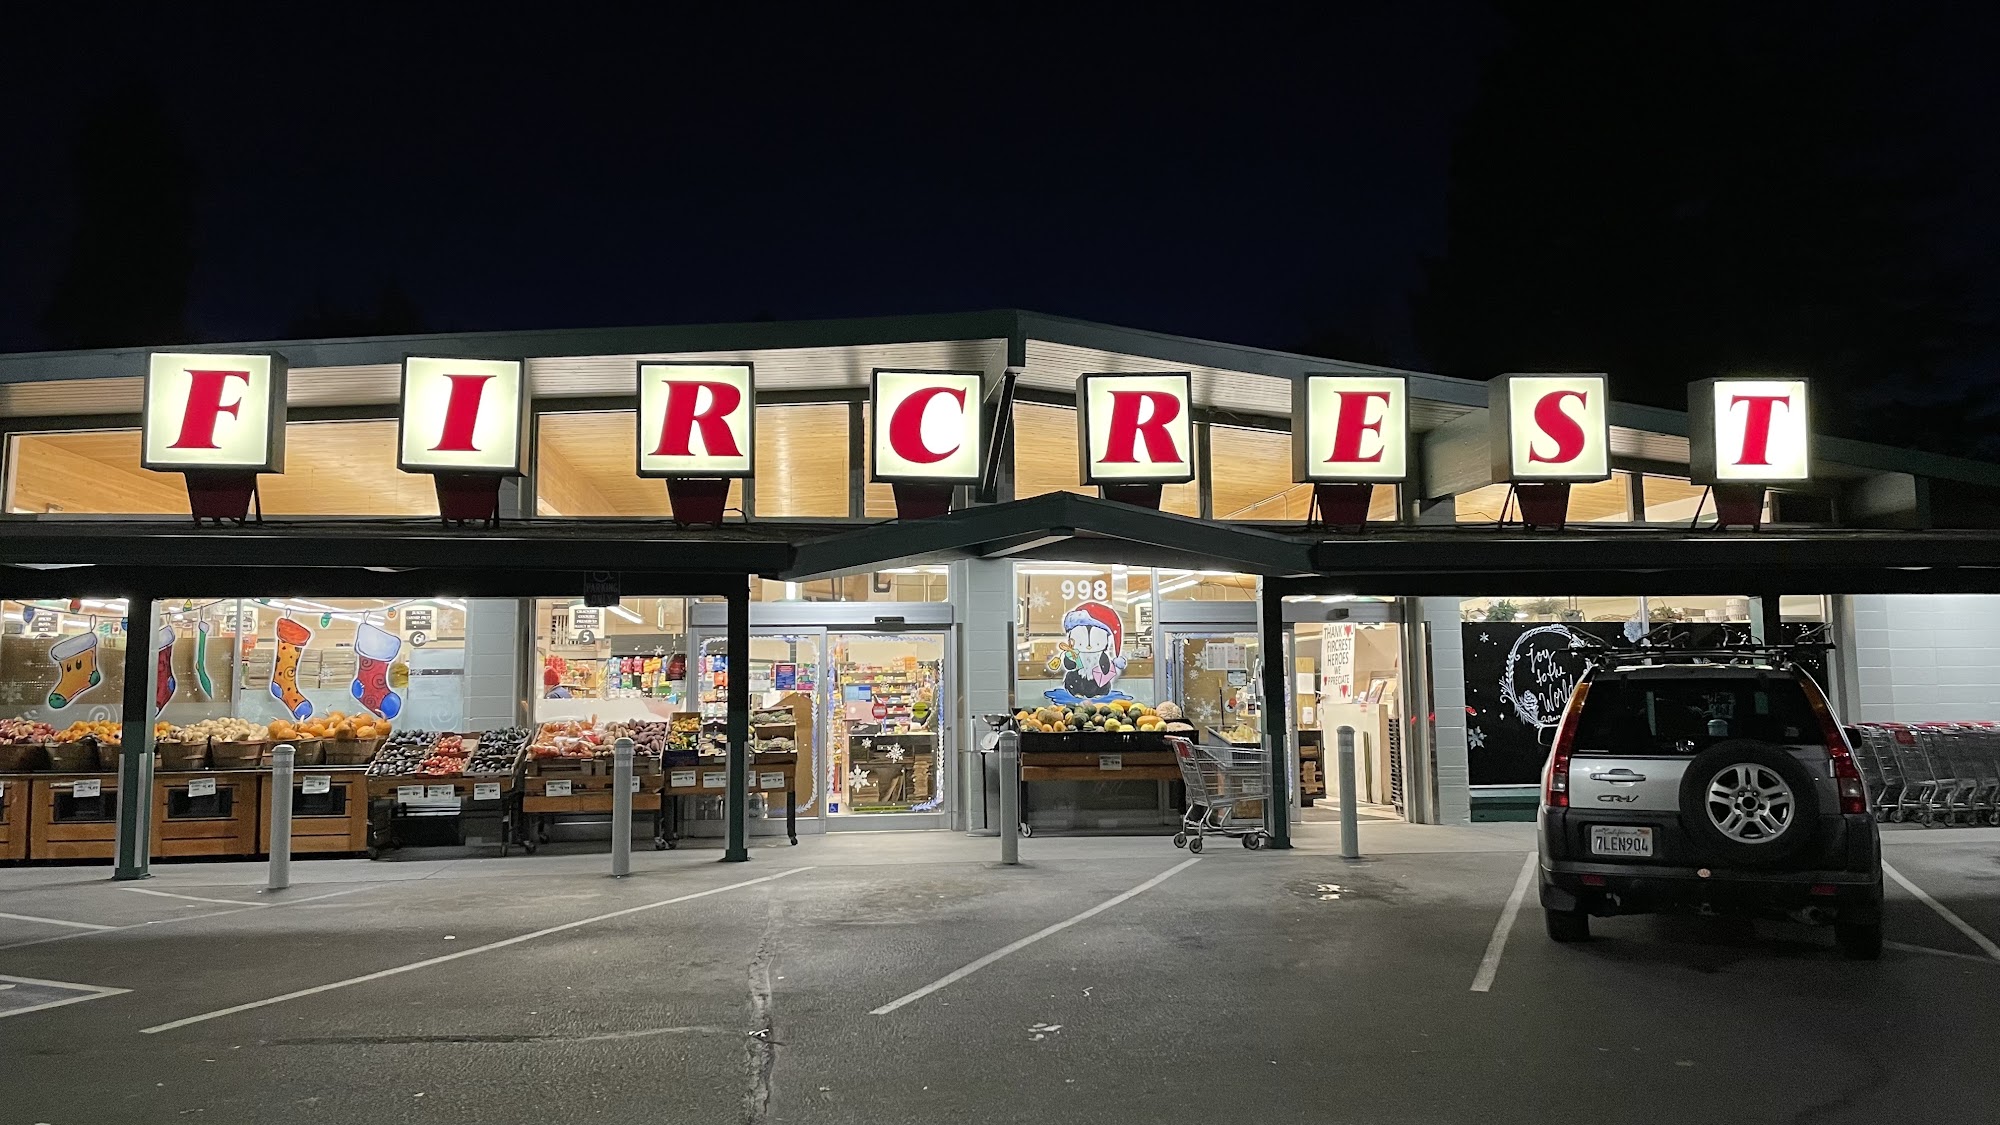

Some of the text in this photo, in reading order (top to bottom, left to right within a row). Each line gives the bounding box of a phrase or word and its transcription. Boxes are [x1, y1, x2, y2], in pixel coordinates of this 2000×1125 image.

[165, 369, 1790, 464] FIRCREST
[585, 582, 618, 593] PARKING
[1061, 579, 1108, 600] 998
[591, 594, 613, 605] ONLY
[413, 632, 425, 645] 6
[582, 631, 591, 643] 5
[1324, 625, 1343, 640] THANK
[1326, 638, 1352, 653] FIRCREST
[1327, 652, 1349, 666] HEROES
[1334, 666, 1341, 675] WE
[1536, 661, 1567, 687] to the
[1323, 674, 1350, 686] PPRECIATE
[1338, 684, 1352, 698] YU
[1596, 836, 1648, 852] 7LEN904
